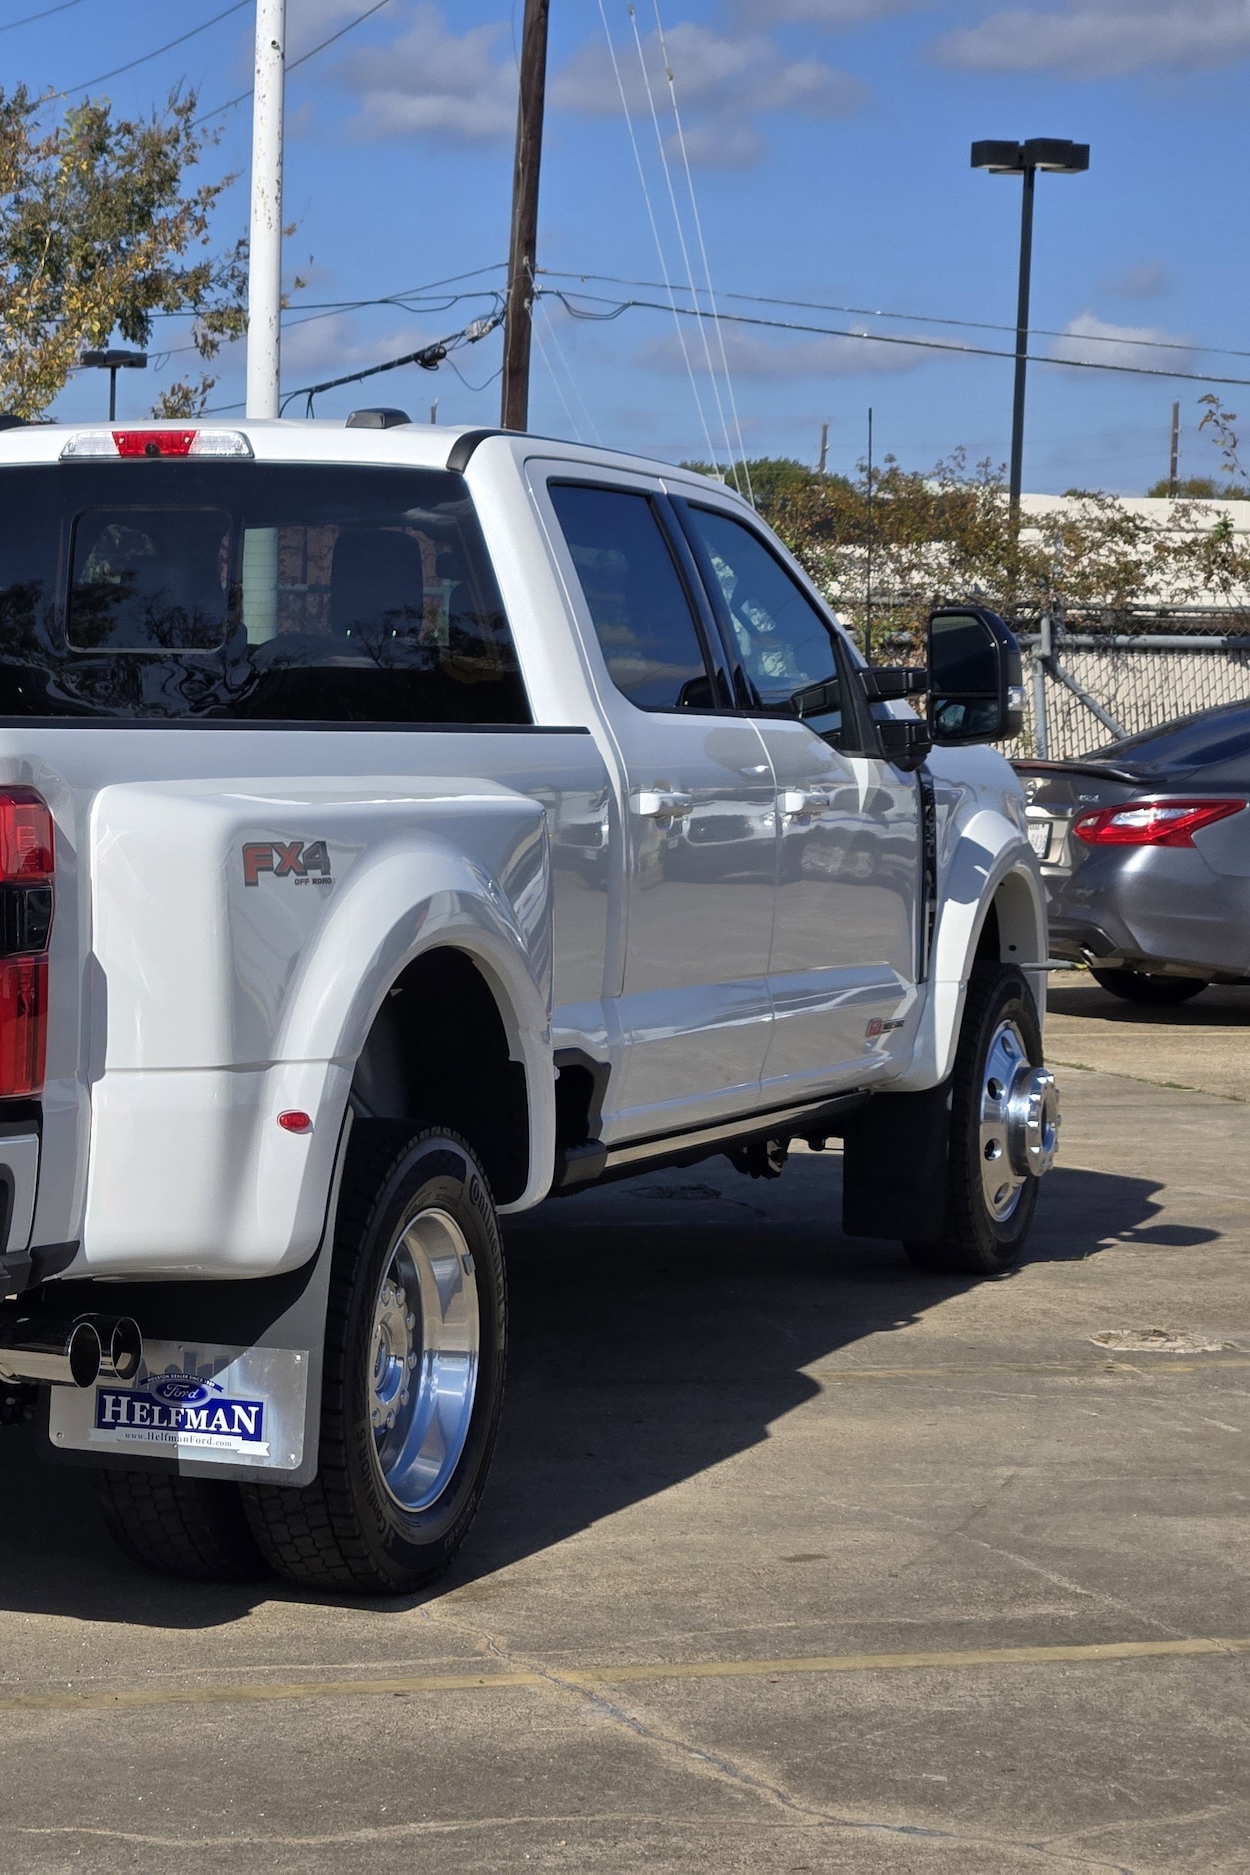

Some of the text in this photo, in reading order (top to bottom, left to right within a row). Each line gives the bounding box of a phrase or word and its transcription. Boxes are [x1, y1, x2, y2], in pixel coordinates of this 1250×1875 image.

[242, 840, 331, 887] FX4
[294, 877, 332, 886] OFF ROAD
[163, 1383, 200, 1399] Ford
[101, 1394, 259, 1435] HELFMAN
[124, 1431, 232, 1447] www.HelfmanFord.com
